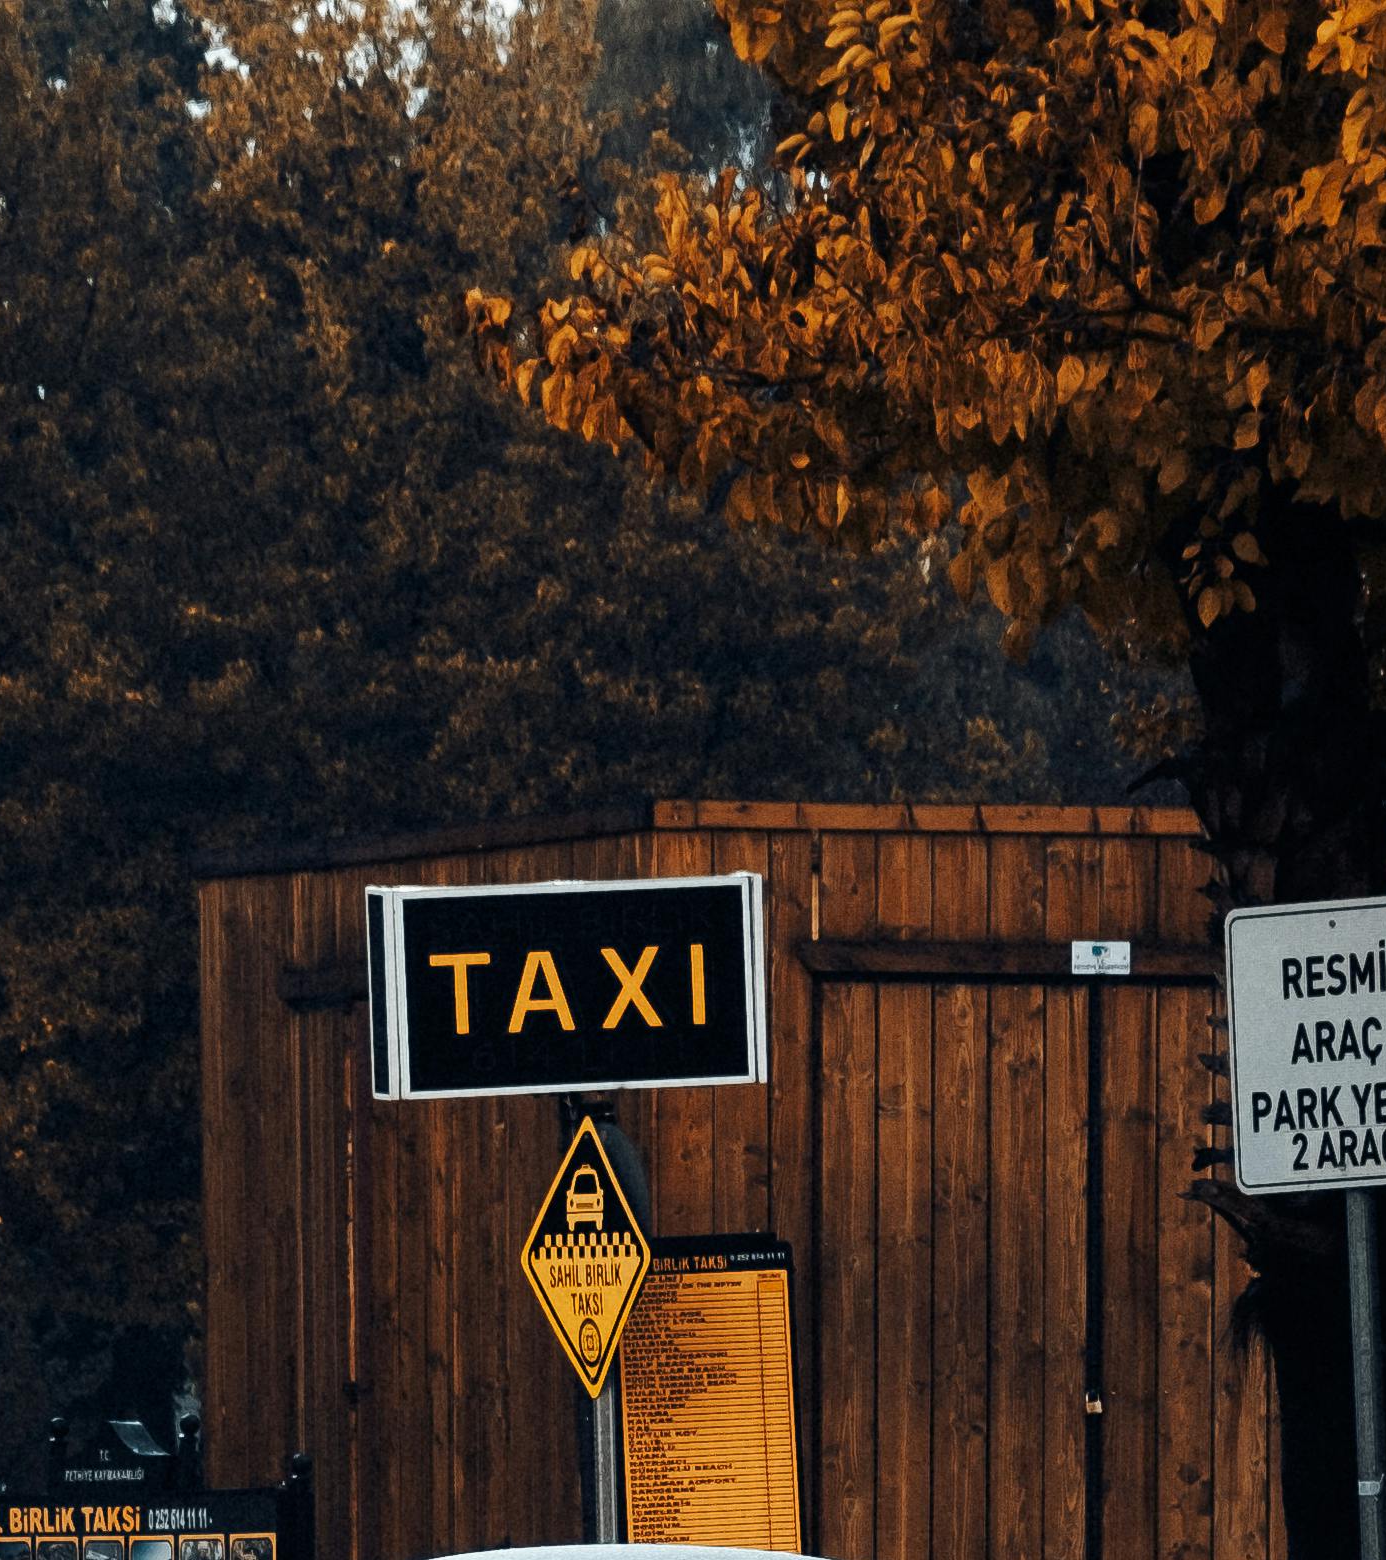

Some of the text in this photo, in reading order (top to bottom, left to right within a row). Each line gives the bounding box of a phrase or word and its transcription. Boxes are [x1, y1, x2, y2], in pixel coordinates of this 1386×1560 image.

[429, 943, 706, 1034] TAXI
[1291, 1016, 1383, 1066] ARAÇ
[1251, 1085, 1344, 1133] PARK
[1292, 1132, 1310, 1171] 2
[571, 1289, 603, 1316] TAKSİ
